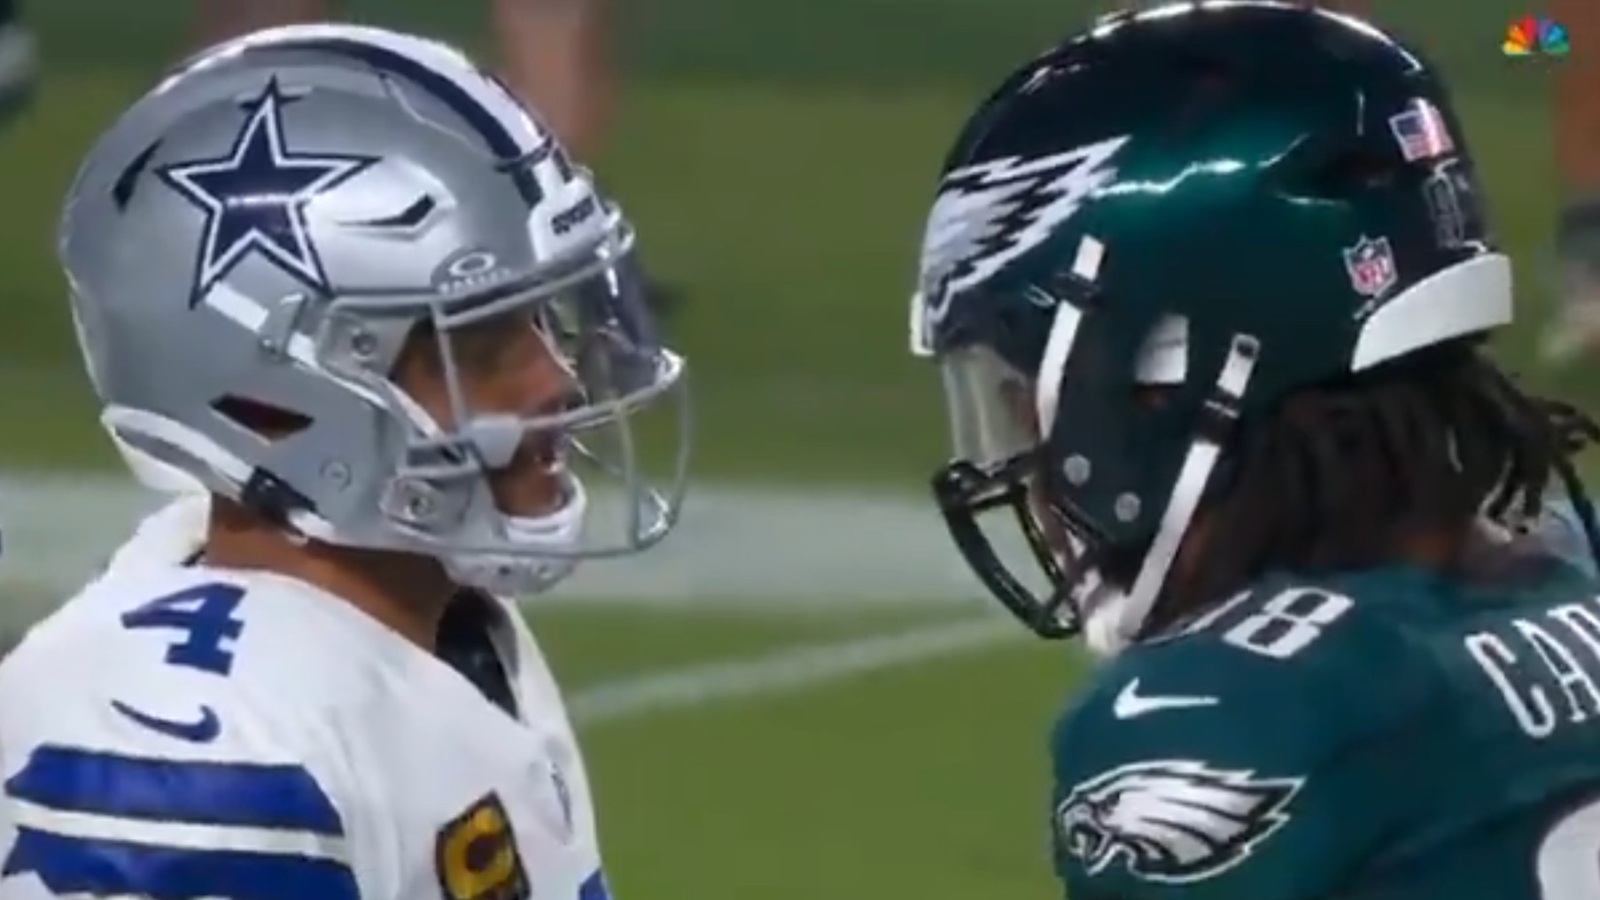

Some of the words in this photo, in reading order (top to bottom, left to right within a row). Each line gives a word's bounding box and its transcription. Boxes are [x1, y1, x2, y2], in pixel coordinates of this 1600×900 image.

[121, 582, 247, 676] 4
[1464, 596, 1600, 738] CA
[444, 806, 514, 898] C
